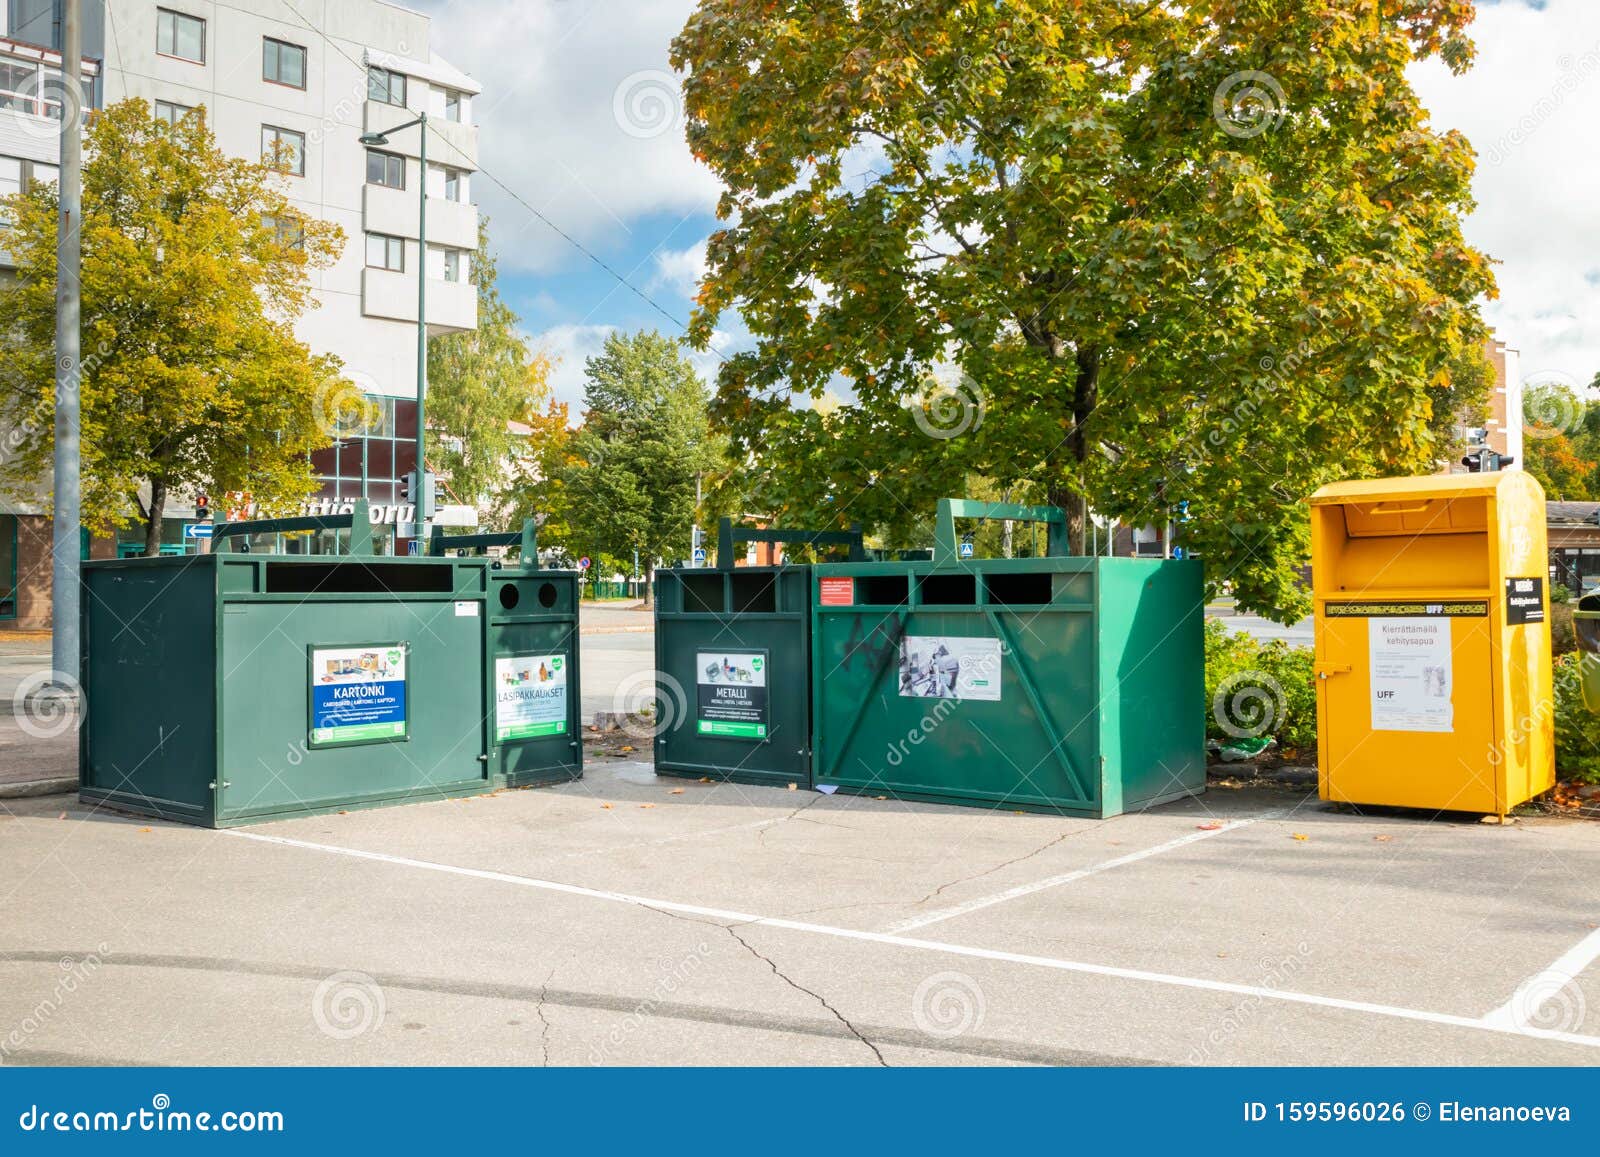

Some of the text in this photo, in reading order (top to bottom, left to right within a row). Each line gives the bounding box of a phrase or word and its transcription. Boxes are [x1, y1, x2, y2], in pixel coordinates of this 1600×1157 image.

[1386, 636, 1434, 647] kehitysapua
[334, 685, 385, 699] KARTONKI
[498, 687, 564, 702] LASIPAKKAUKSET
[716, 687, 747, 699] METALLI
[1377, 690, 1395, 699] UFF
